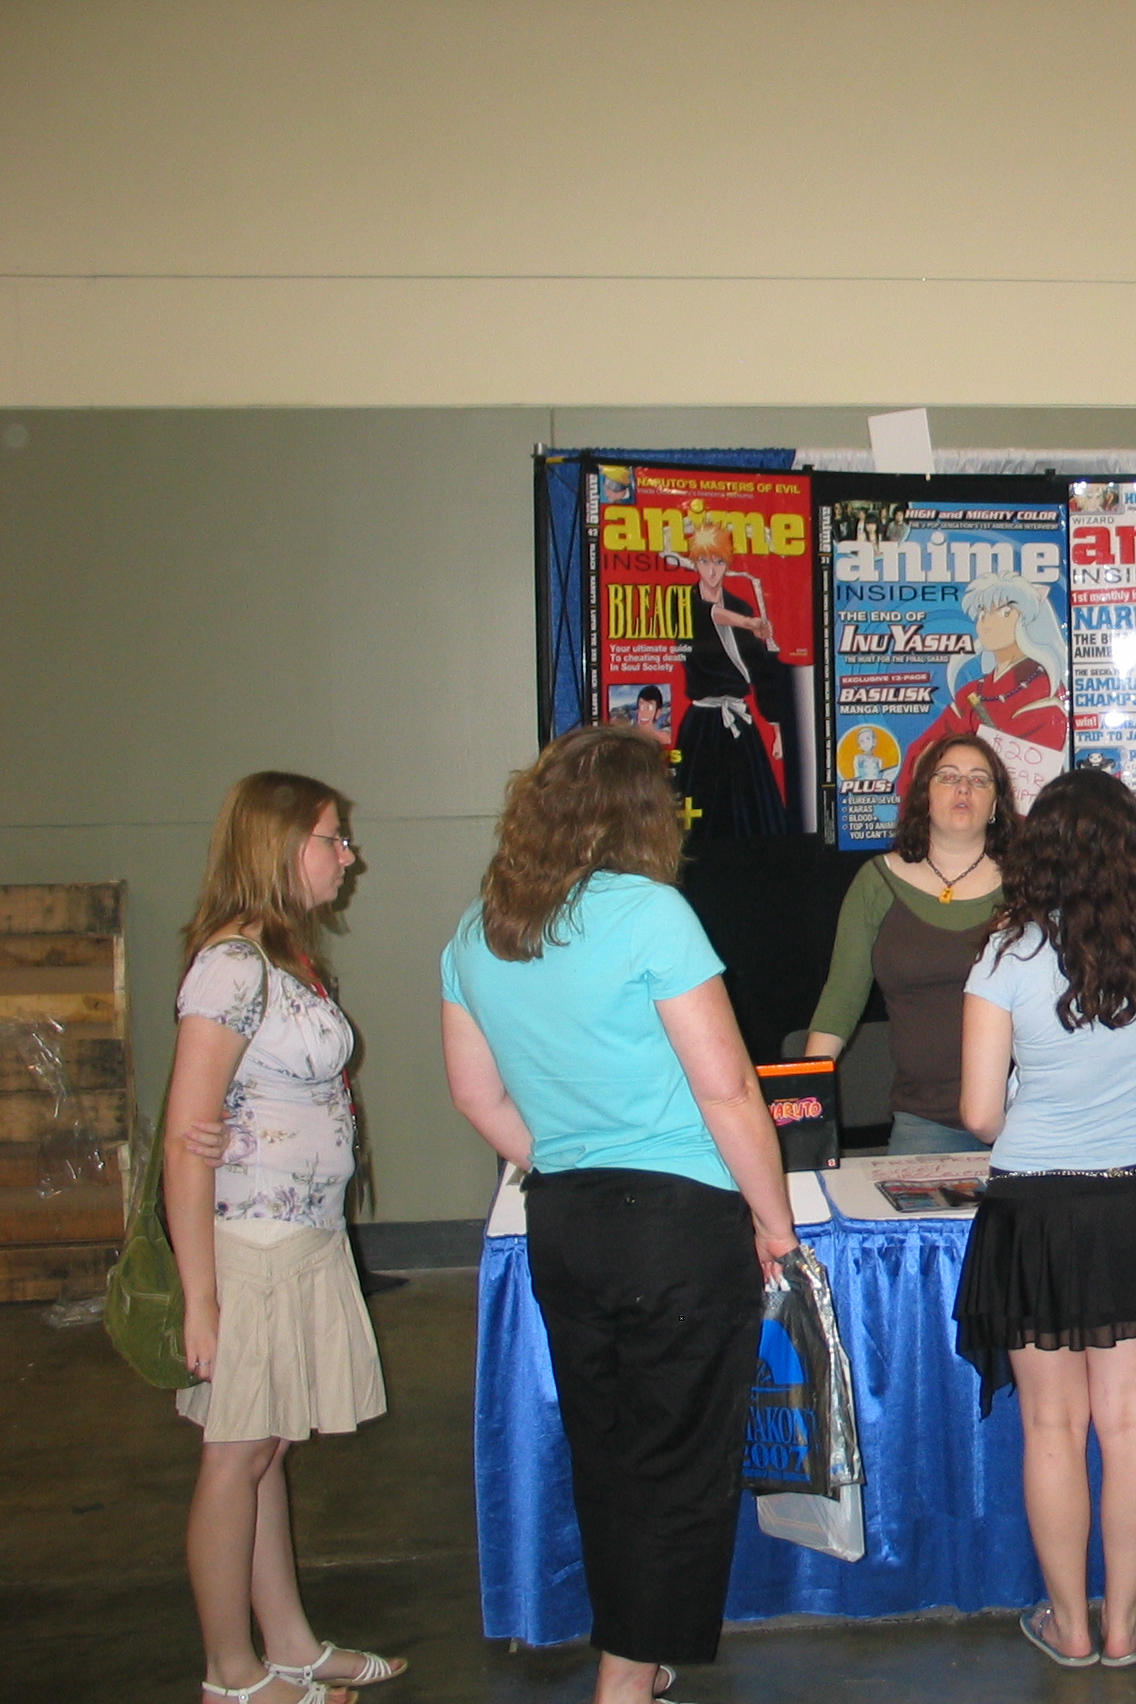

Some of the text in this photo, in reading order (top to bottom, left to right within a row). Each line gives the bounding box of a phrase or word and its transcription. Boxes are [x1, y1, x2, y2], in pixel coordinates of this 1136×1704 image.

[636, 477, 801, 494] NARUTO'S MASTERS OF EVIL
[904, 509, 1059, 521] HIGH and MIGHTY COLOR
[1073, 516, 1115, 525] WIZARD
[603, 499, 806, 556] anime
[603, 553, 695, 572] INSID
[836, 532, 1060, 583] anime
[837, 585, 959, 602] INSIDER
[1071, 592, 1088, 603] 1st
[1090, 589, 1130, 604] monthly
[607, 584, 694, 640] BLEACH
[838, 611, 926, 622] THE END OF
[1074, 633, 1097, 646] THE
[610, 644, 693, 654] Your ultimate guide
[610, 653, 687, 663] To cheating death
[610, 663, 674, 673] In Soul Society
[840, 687, 932, 703] BASILISK
[840, 704, 930, 714] MANGA PREVIEW
[1076, 730, 1103, 742] TRIP
[1108, 731, 1122, 741] TO
[993, 734, 1043, 765] $20
[1006, 766, 1045, 789] EAR
[840, 779, 893, 794] PLUS:
[848, 805, 873, 814] KARAS
[849, 822, 863, 831] TOP
[875, 822, 896, 830] ANIM
[850, 831, 865, 840] YOU
